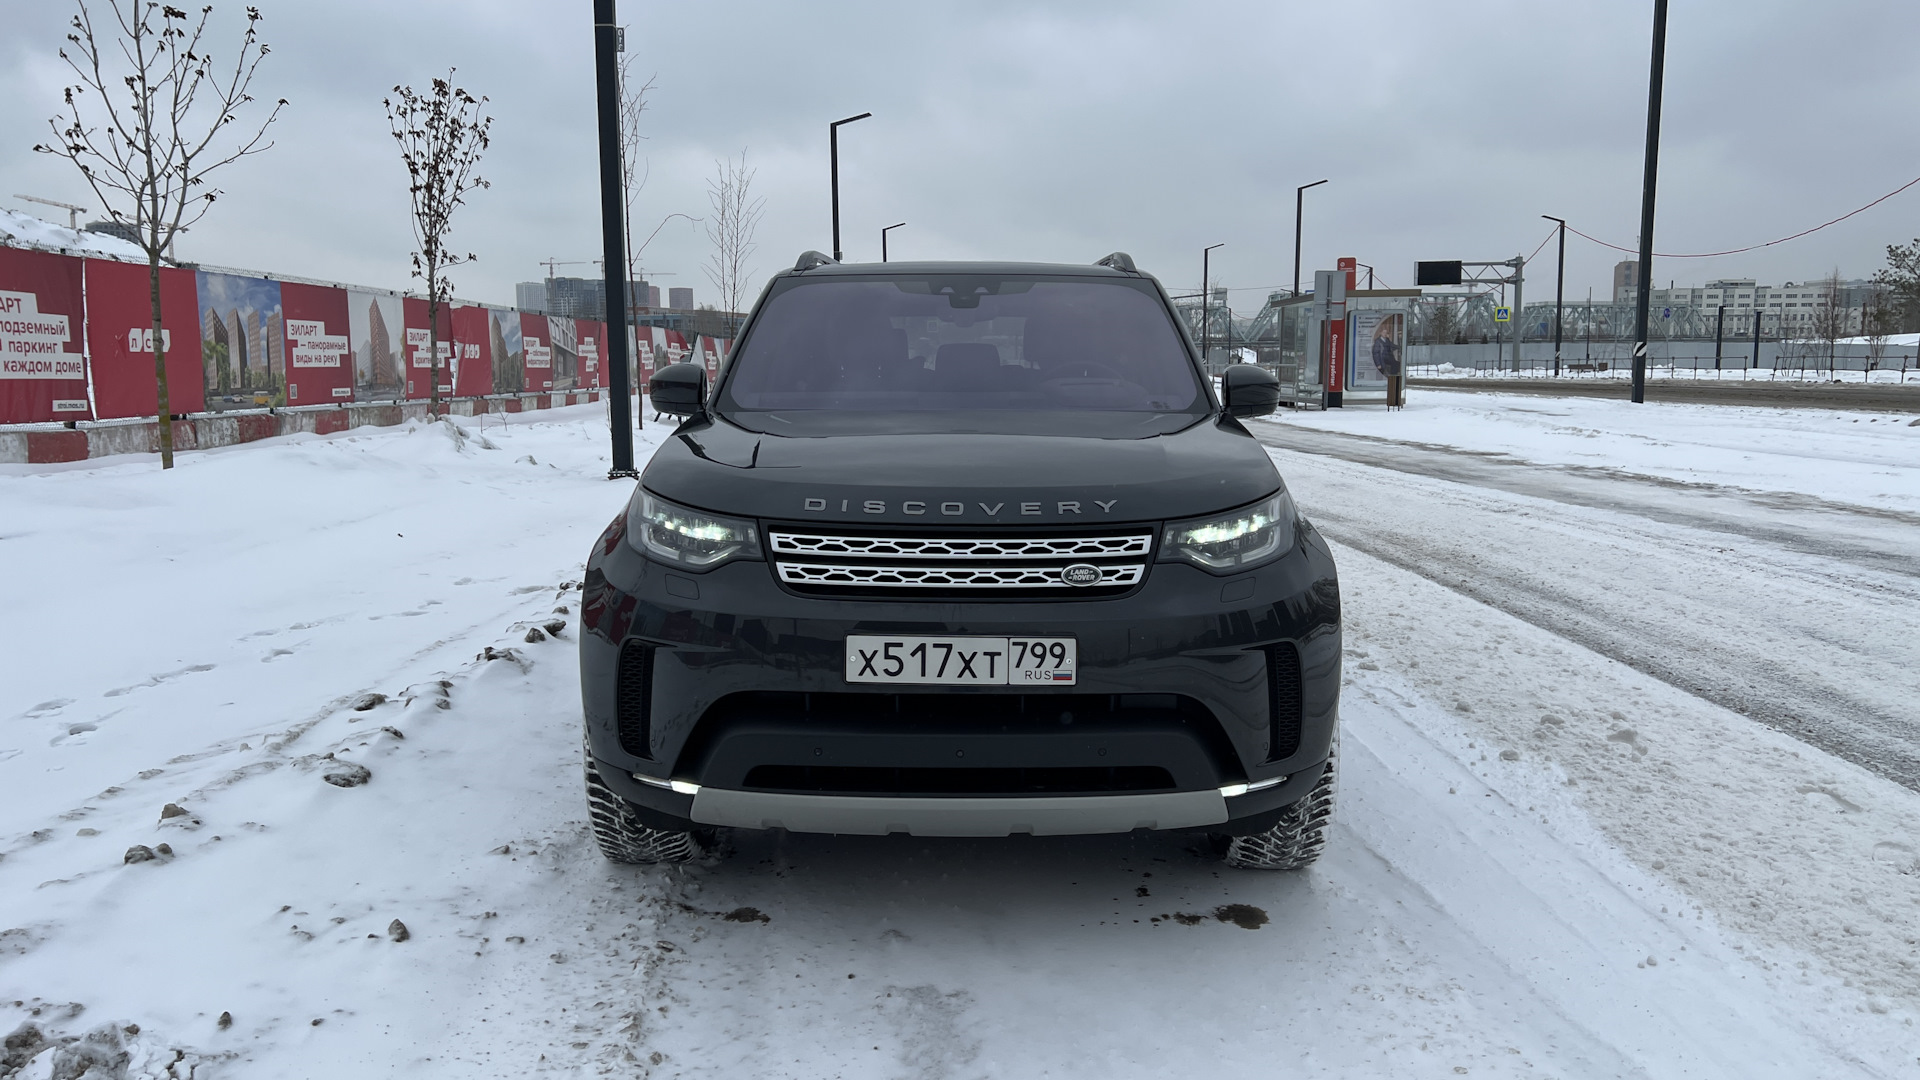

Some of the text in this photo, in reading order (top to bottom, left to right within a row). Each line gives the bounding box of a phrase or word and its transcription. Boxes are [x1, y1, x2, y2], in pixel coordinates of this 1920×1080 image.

[290, 324, 318, 336] ЗИЛАРТ
[409, 332, 428, 342] ЗИЛАРТ
[8, 340, 58, 357] паркинг
[307, 341, 346, 352] панорамные
[425, 346, 448, 354] авская
[295, 354, 338, 365] виды на реку
[3, 360, 81, 375] каждом доме
[804, 497, 1118, 516] DISCOVERY
[1011, 641, 1067, 669] 799
[1024, 670, 1052, 680] RUS
